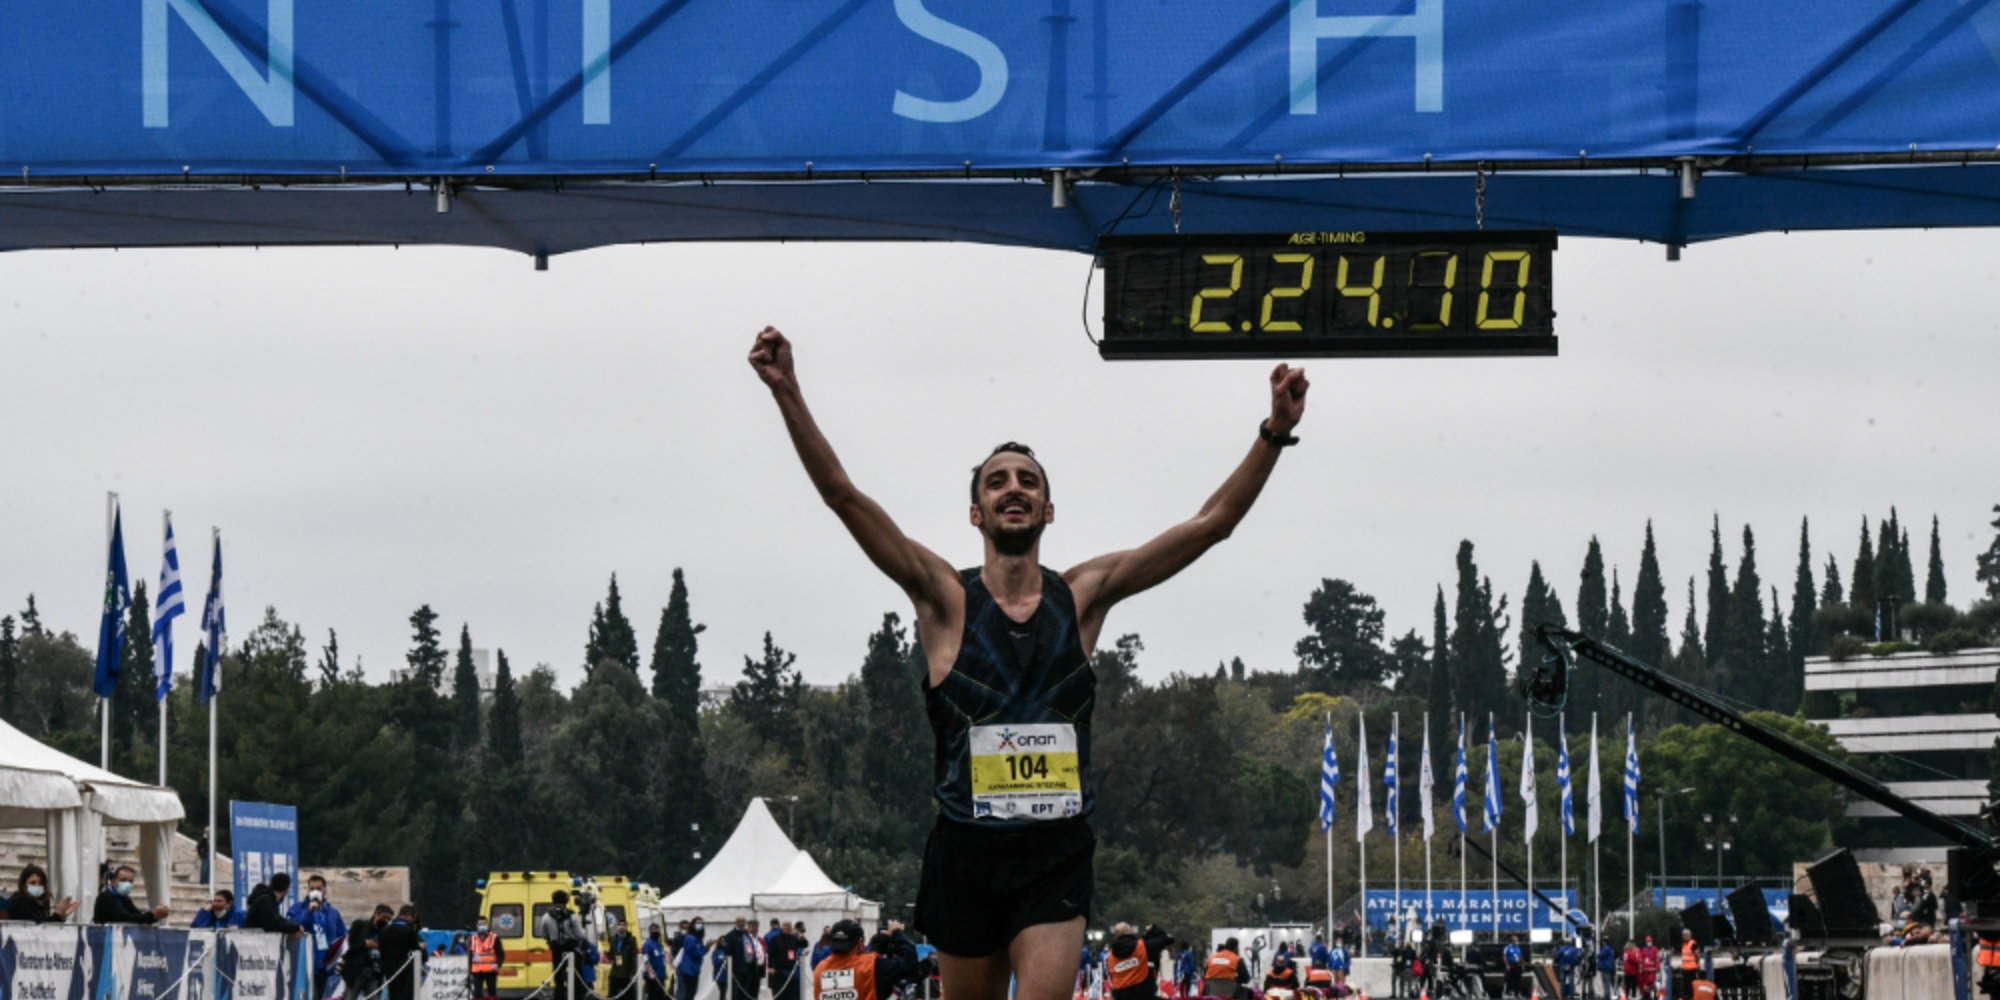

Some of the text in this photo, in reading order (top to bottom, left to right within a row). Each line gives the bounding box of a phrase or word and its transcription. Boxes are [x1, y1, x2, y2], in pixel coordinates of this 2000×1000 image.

[1006, 755, 1048, 781] 104
[1367, 898, 1539, 910] ATHENS MARATHON
[1384, 912, 1523, 924] TH AUTHENTIC
